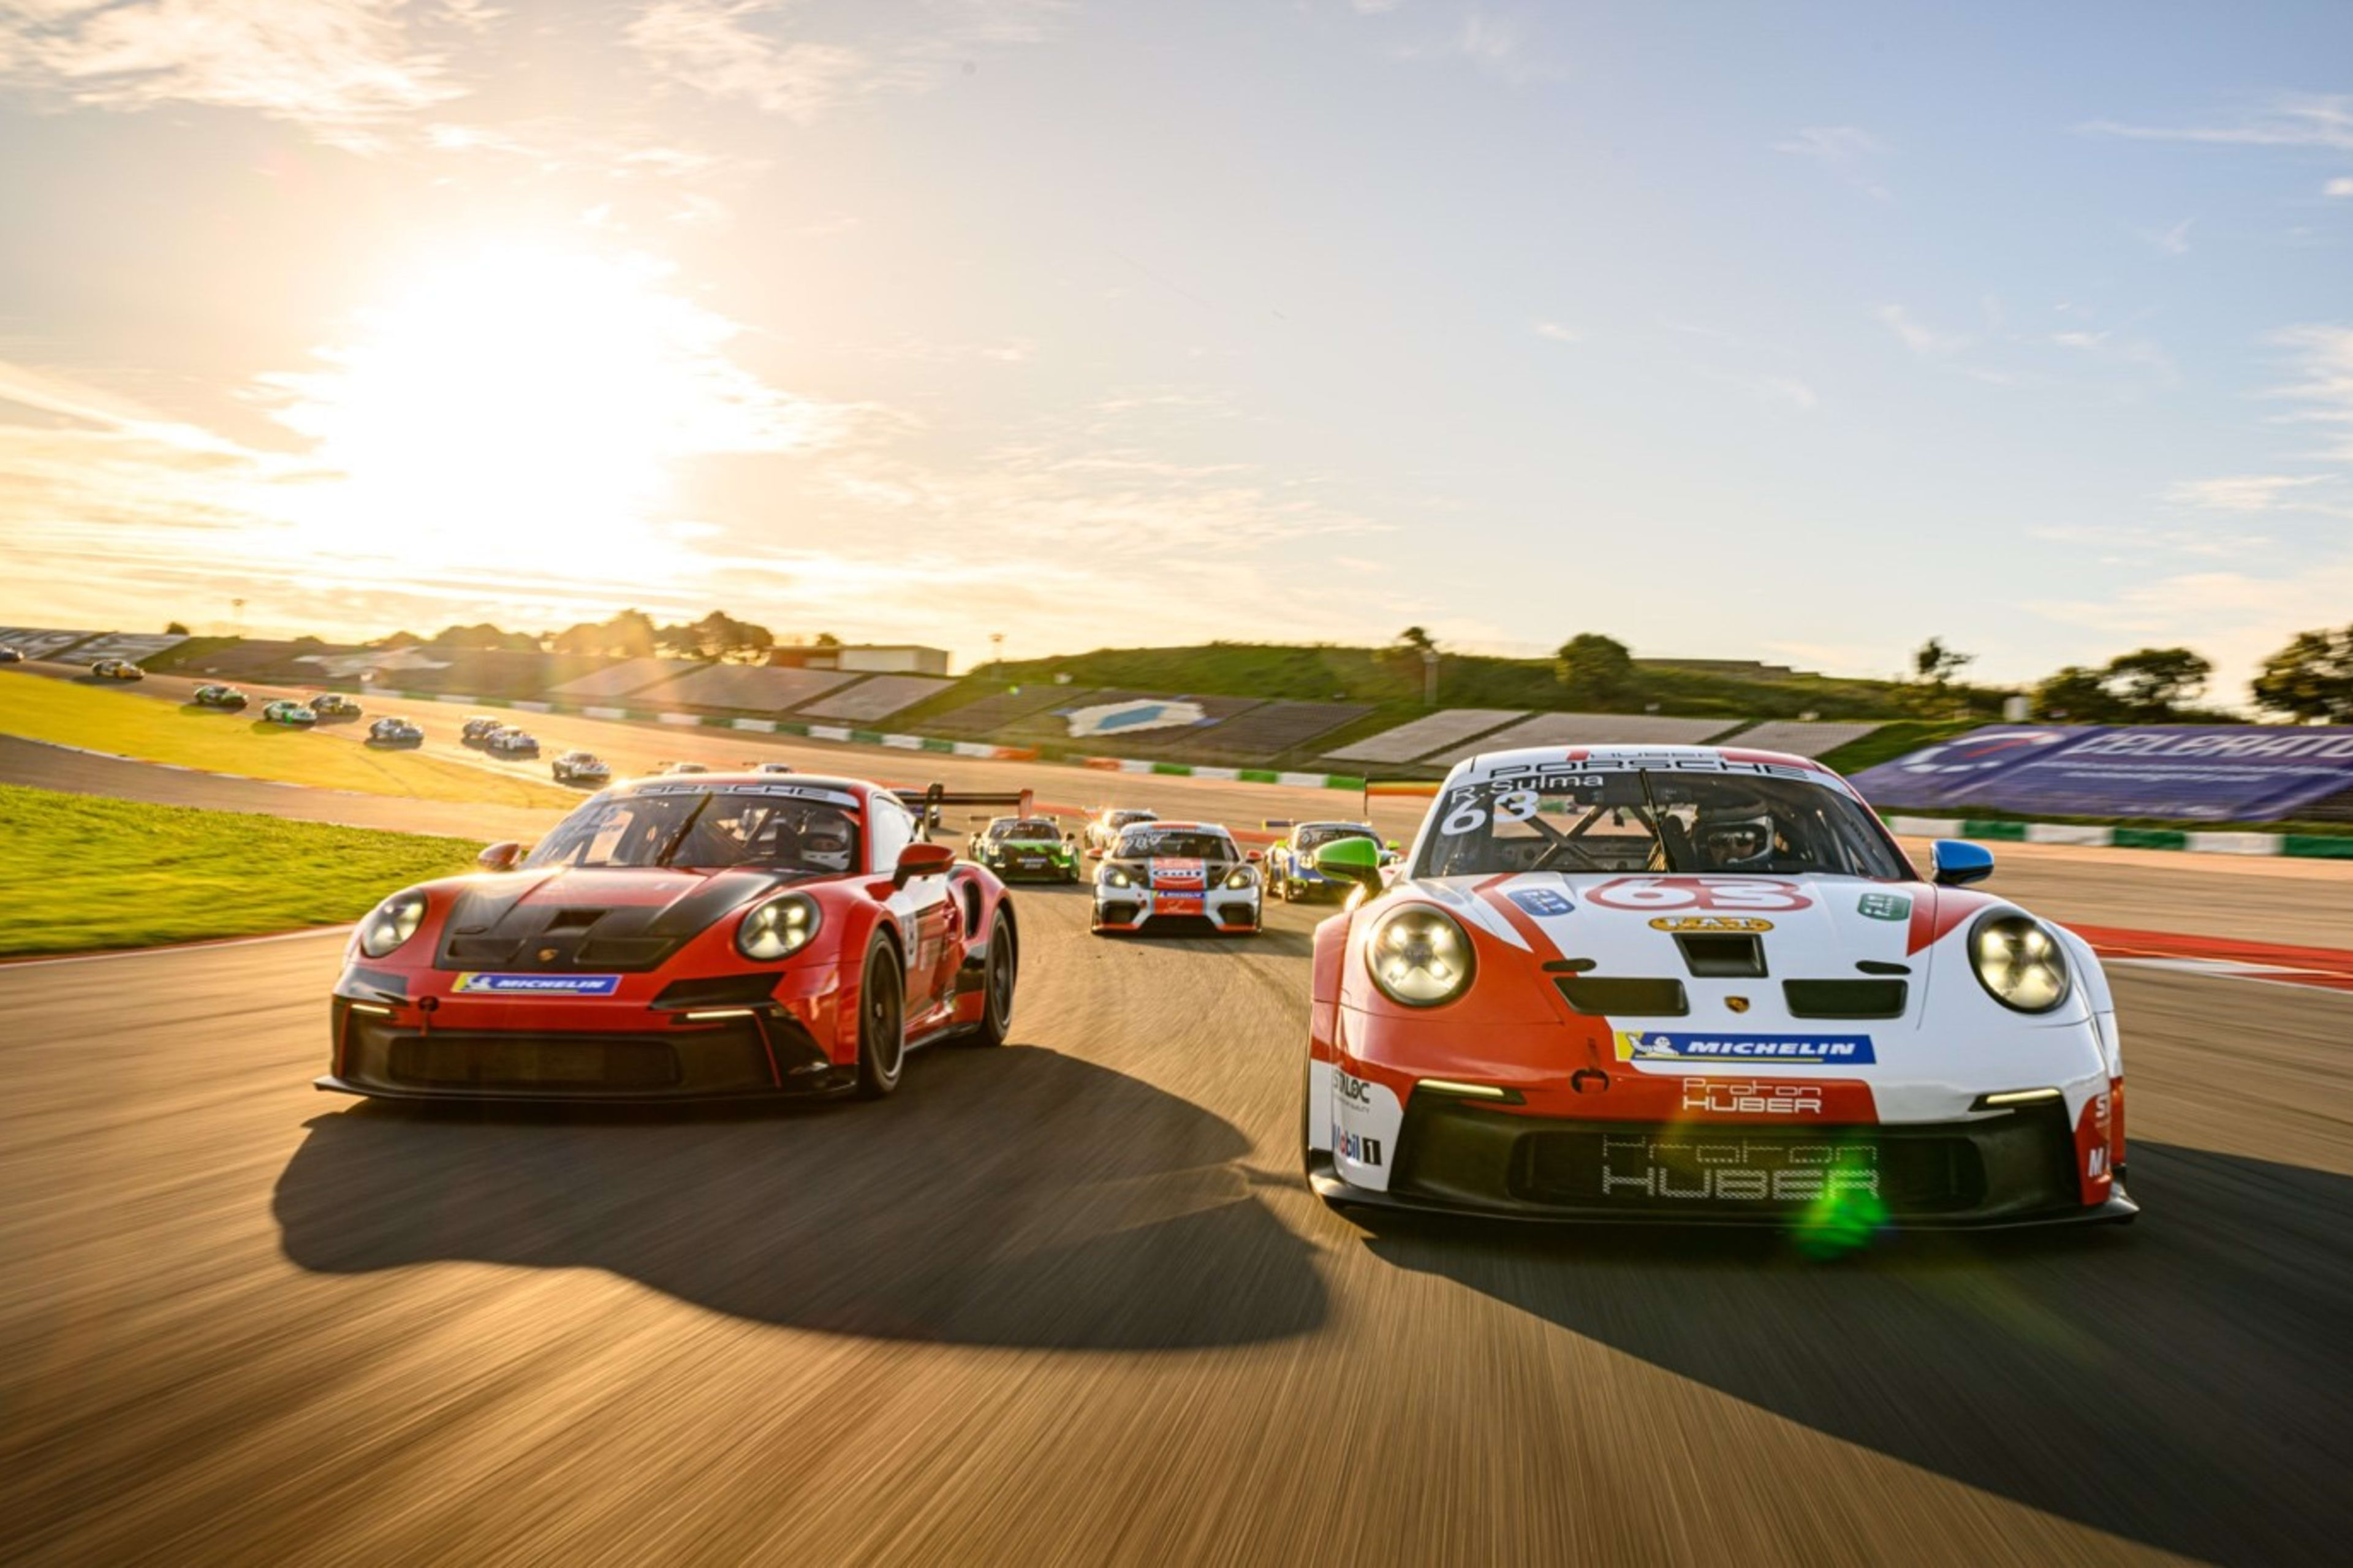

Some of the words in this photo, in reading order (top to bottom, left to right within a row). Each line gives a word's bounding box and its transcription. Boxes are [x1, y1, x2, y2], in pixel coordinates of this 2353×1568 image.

[1489, 759, 1809, 779] PORSCHE
[1441, 789, 1539, 836] 63
[1585, 877, 1812, 911] 63
[496, 980, 606, 988] MICHELIN
[1687, 1042, 1856, 1056] MICHELIN
[1683, 1078, 1821, 1096] Proton
[1683, 1096, 1821, 1113] HUBER
[1602, 1165, 1879, 1200] HUBER
